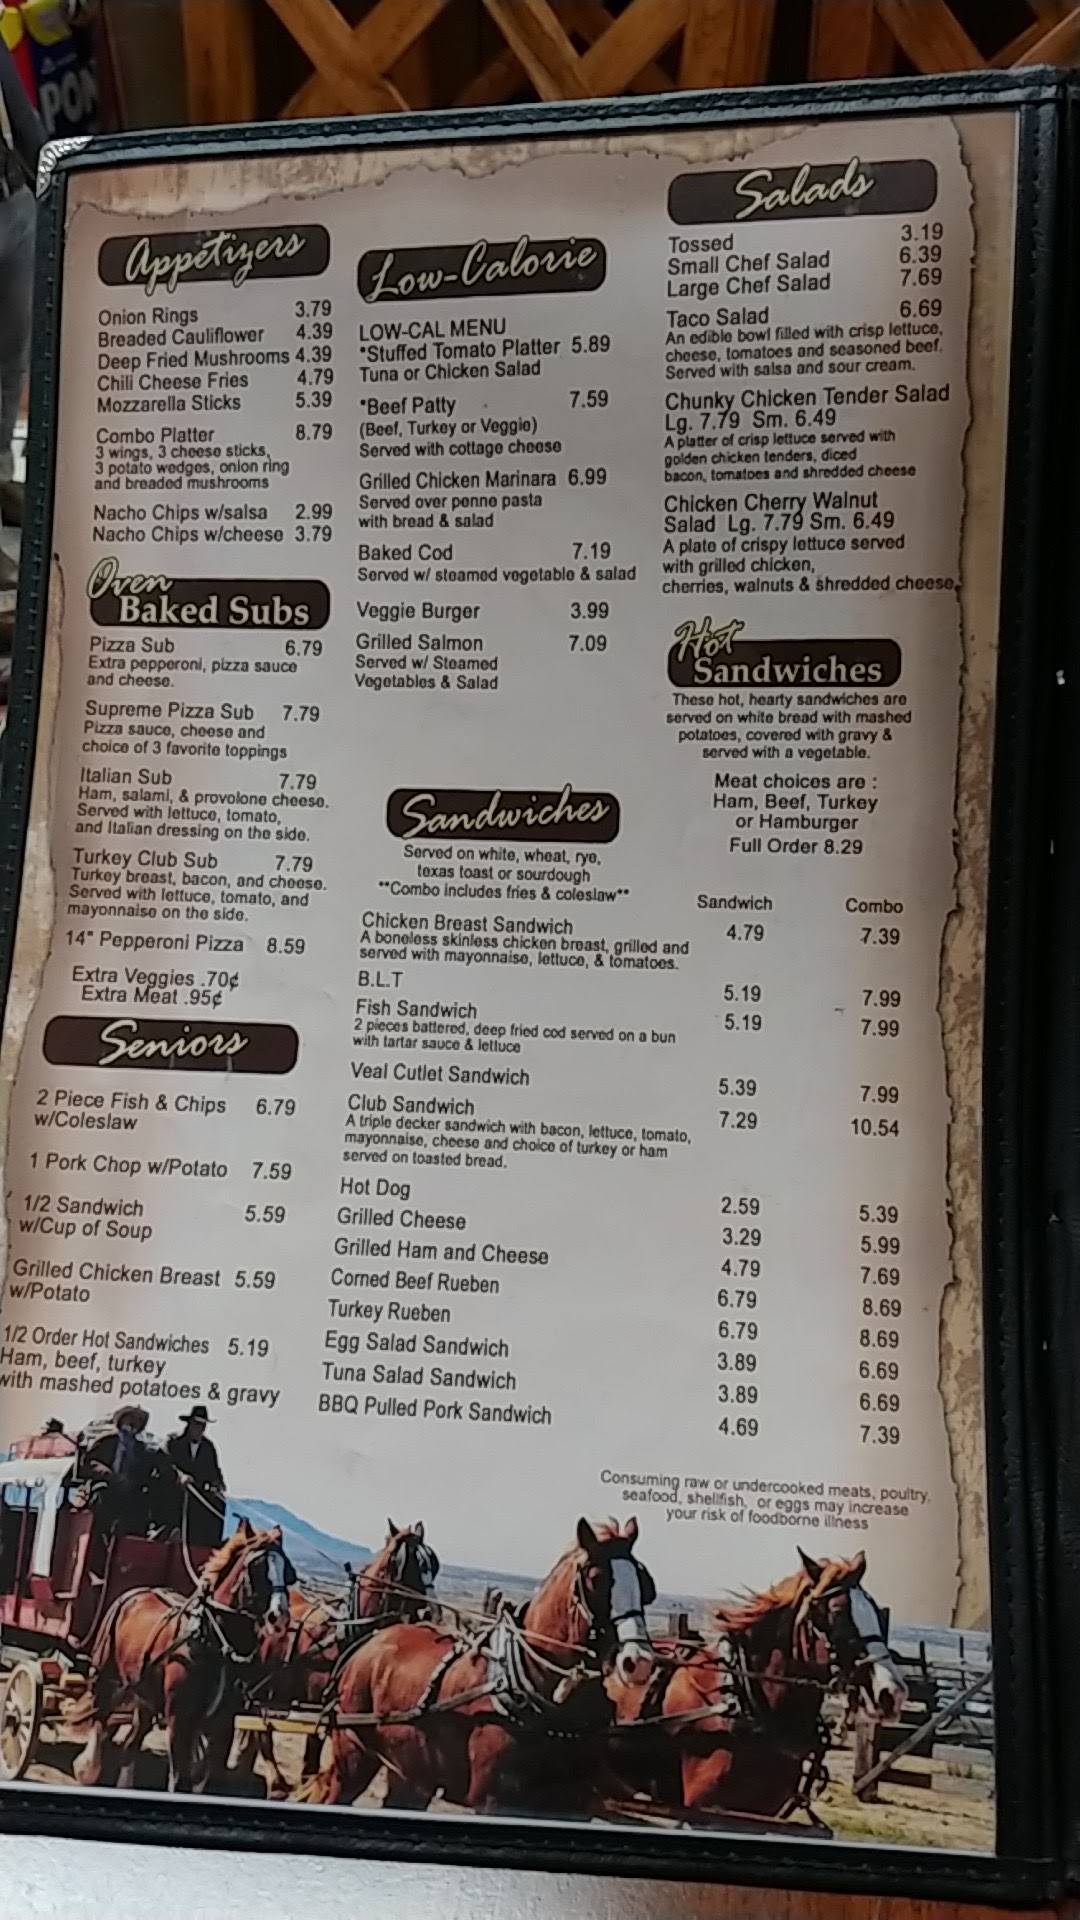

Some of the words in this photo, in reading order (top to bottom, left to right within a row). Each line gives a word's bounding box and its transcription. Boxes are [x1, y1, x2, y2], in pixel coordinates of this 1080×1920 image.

[735, 156, 875, 220] Salads
[668, 233, 733, 253] Tossed
[900, 222, 943, 241] 3.19
[125, 232, 306, 296] Appetizers
[366, 235, 598, 303] Low-Calorie
[667, 256, 718, 275] Small
[725, 252, 771, 272] Chef
[776, 250, 830, 269] Salad
[899, 244, 941, 263] 6.39
[98, 309, 146, 325] Onion
[152, 307, 198, 326] Rings
[295, 299, 331, 317] 3.79
[666, 310, 710, 327] Taco
[716, 306, 769, 325] Salad
[899, 298, 942, 317] 6.69
[98, 330, 166, 347] Breaded
[171, 327, 264, 344] Cauliflower
[295, 322, 332, 339] 4.39
[359, 321, 445, 341] LOW-CAL
[450, 318, 506, 336] MENU
[98, 353, 141, 371] Deep
[146, 351, 188, 367] Fried
[194, 350, 290, 366] Mushrooms
[295, 345, 332, 362] 4.39
[665, 364, 715, 379] Served
[719, 363, 748, 376] with
[753, 362, 791, 376] salsa
[796, 360, 823, 374] and
[828, 361, 861, 373] sour
[865, 359, 916, 372] cream.
[359, 366, 398, 382] Tuna
[403, 367, 420, 380] or
[424, 363, 489, 379] Chicken
[494, 359, 540, 377] Salad
[665, 391, 735, 414] Chunky
[740, 389, 816, 407] Chicken
[822, 386, 888, 404] Tender
[894, 384, 949, 402] Salad
[665, 413, 692, 435] Lg.
[700, 410, 740, 429] 7.79
[752, 409, 787, 428] Sm.
[795, 407, 836, 426] 6.49
[96, 427, 154, 443] Combo
[160, 427, 215, 442] Platter
[295, 422, 332, 440] 8.79
[94, 475, 120, 489] and
[125, 476, 182, 489] breaded
[186, 475, 269, 489] mushrooms
[359, 472, 410, 489] Grilled
[415, 471, 479, 488] Chicken
[485, 470, 556, 487] Marinara
[567, 467, 606, 485] 6.99
[93, 504, 146, 520] Nacho
[152, 503, 199, 523] Chips
[204, 503, 267, 519] w/salsa
[295, 503, 332, 519] 2.99
[358, 544, 412, 560] Baked
[418, 543, 453, 560] Cod
[572, 541, 610, 559] 7.19
[87, 555, 173, 600] Oven
[118, 595, 218, 624] Baked
[229, 596, 310, 626] Subs
[356, 601, 415, 621] Veggie
[422, 602, 480, 622] Burger
[570, 601, 609, 618] 3.99
[355, 632, 412, 649] Grilled
[417, 633, 483, 651] Salmon
[568, 634, 607, 651] 7.09
[674, 616, 745, 662] Hot
[354, 673, 436, 690] Vegetables
[440, 674, 450, 689] &
[456, 674, 498, 689] Salad
[693, 656, 882, 685] Sandwiches
[85, 699, 162, 721] Supreme
[167, 701, 214, 718] Pizza
[220, 702, 254, 720] Sub
[283, 704, 319, 722] 7.79
[401, 783, 610, 840] Sandwiches
[713, 793, 758, 810] Ham,
[765, 793, 810, 810] Beef,
[816, 793, 878, 813] Turkey
[729, 836, 761, 852] Full
[767, 837, 818, 853] Order
[823, 838, 863, 854] 8.29
[73, 847, 132, 871] Turkey
[137, 849, 177, 867] Club
[183, 851, 218, 868] Sub
[275, 854, 313, 872] 7.79
[697, 895, 773, 911] Sandwich
[846, 898, 904, 914] Combo
[362, 911, 428, 929] Chicken
[434, 913, 487, 931] Breast
[493, 915, 573, 934] Sandwich
[726, 924, 764, 941] 4.79
[66, 930, 93, 945] 14"
[99, 930, 189, 950] Pepperoni
[195, 934, 243, 951] Pizza
[266, 937, 305, 954] 8.59
[860, 927, 900, 945] 7.39
[72, 965, 117, 982] Extra
[124, 967, 194, 990] Veggies
[358, 970, 403, 987] B.L.T
[723, 984, 761, 1002] 5.19
[862, 989, 901, 1007] 7.99
[355, 998, 390, 1015] Fish
[396, 999, 477, 1018] Sandwich
[98, 1019, 249, 1066] Seniors
[350, 1061, 388, 1078] Veal
[393, 1062, 442, 1081] Cutlet
[448, 1065, 529, 1085] Sandwich
[718, 1078, 757, 1096] 5.39
[860, 1086, 898, 1104] 7.99
[36, 1088, 48, 1105] 2
[54, 1089, 104, 1108] Piece
[110, 1091, 148, 1109] Fish
[155, 1093, 167, 1110] &
[174, 1094, 226, 1115] Chips
[256, 1098, 295, 1115] 6.79
[34, 1110, 138, 1129] w/Coleslaw
[340, 1177, 370, 1195] Hot
[376, 1178, 410, 1200] Dog
[721, 1196, 759, 1215] 2.59
[859, 1204, 898, 1223] 5.39
[337, 1206, 394, 1226] Grilled
[399, 1209, 466, 1229] Cheese
[722, 1227, 761, 1246] 3.29
[860, 1235, 900, 1254] 5.99
[13, 1258, 73, 1278] Grilled
[79, 1262, 153, 1282] Chicken
[159, 1266, 220, 1286] Breast
[234, 1270, 275, 1289] 5.59
[331, 1267, 390, 1287] Corned
[395, 1270, 433, 1289] Beef
[437, 1273, 499, 1292] Rueben
[9, 1282, 90, 1302] w/Potato
[717, 1288, 756, 1308] 6.79
[862, 1297, 901, 1317] 8.69
[318, 1393, 358, 1414] BBQ
[364, 1395, 417, 1416] Pulled
[423, 1399, 463, 1419] Pork
[468, 1402, 551, 1423] Sandwich
[718, 1417, 758, 1436] 4.69
[860, 1424, 900, 1444] 7.39
[666, 1508, 697, 1521] your
[700, 1508, 726, 1520] risk
[730, 1509, 744, 1522] of
[748, 1509, 820, 1527] foodborne
[824, 1512, 868, 1529] illness
